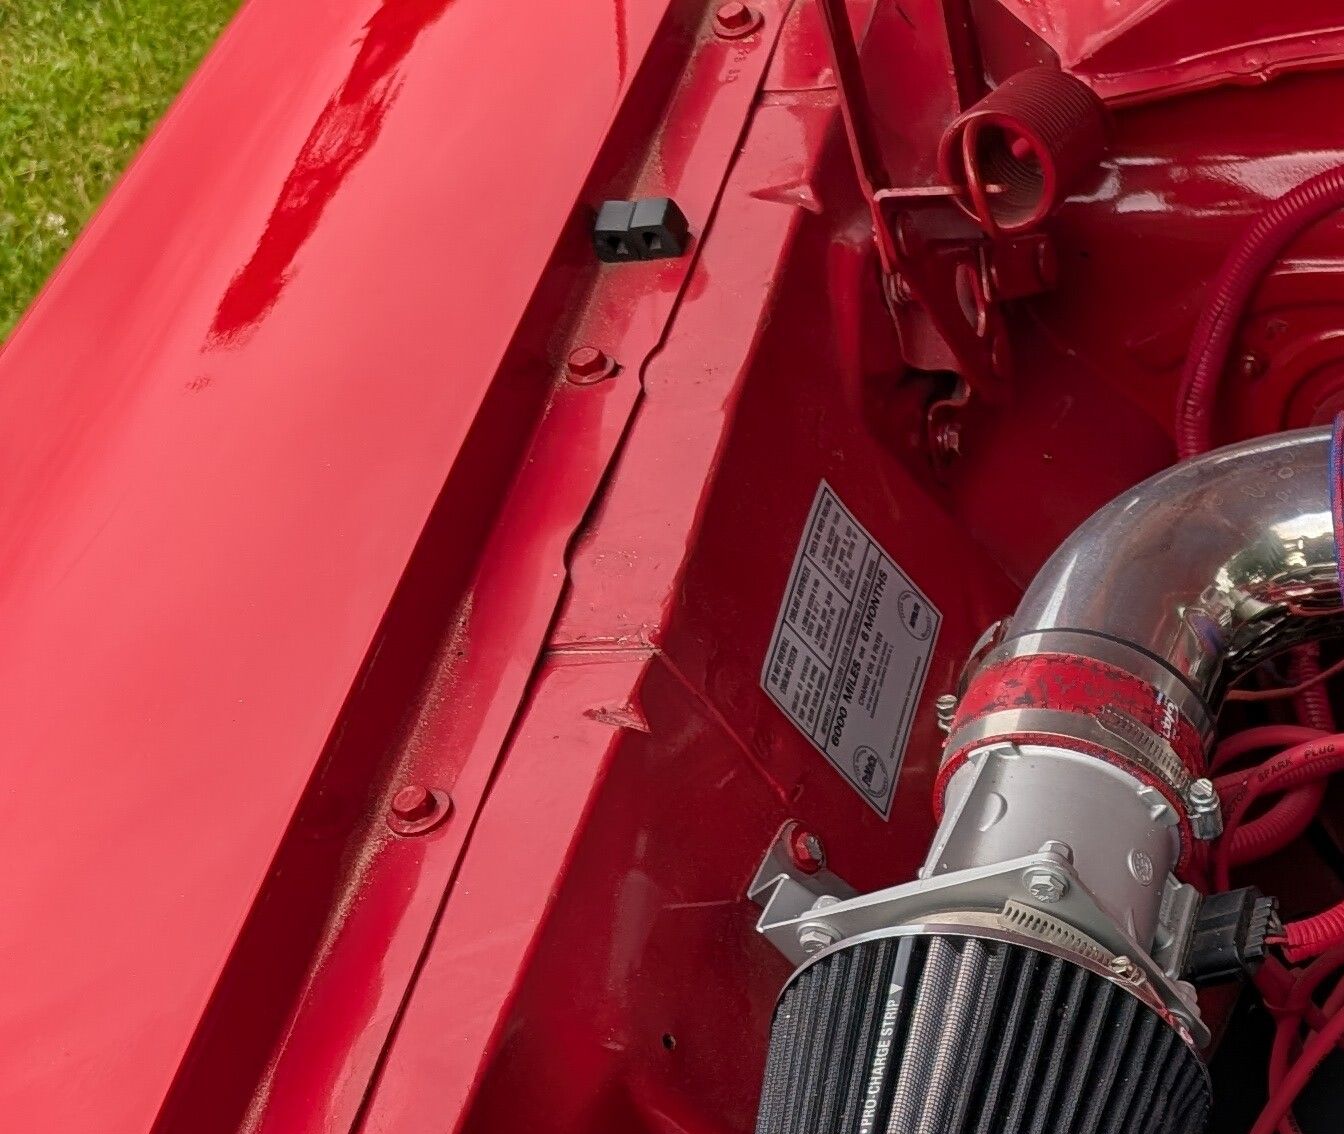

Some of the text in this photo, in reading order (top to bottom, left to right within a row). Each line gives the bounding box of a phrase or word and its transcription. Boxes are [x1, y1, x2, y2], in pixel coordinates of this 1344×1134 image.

[863, 566, 888, 634] MONTHS
[860, 628, 869, 644] 6
[842, 656, 861, 705] MILES
[830, 703, 848, 748] 6000
[882, 999, 899, 1038] STRIP
